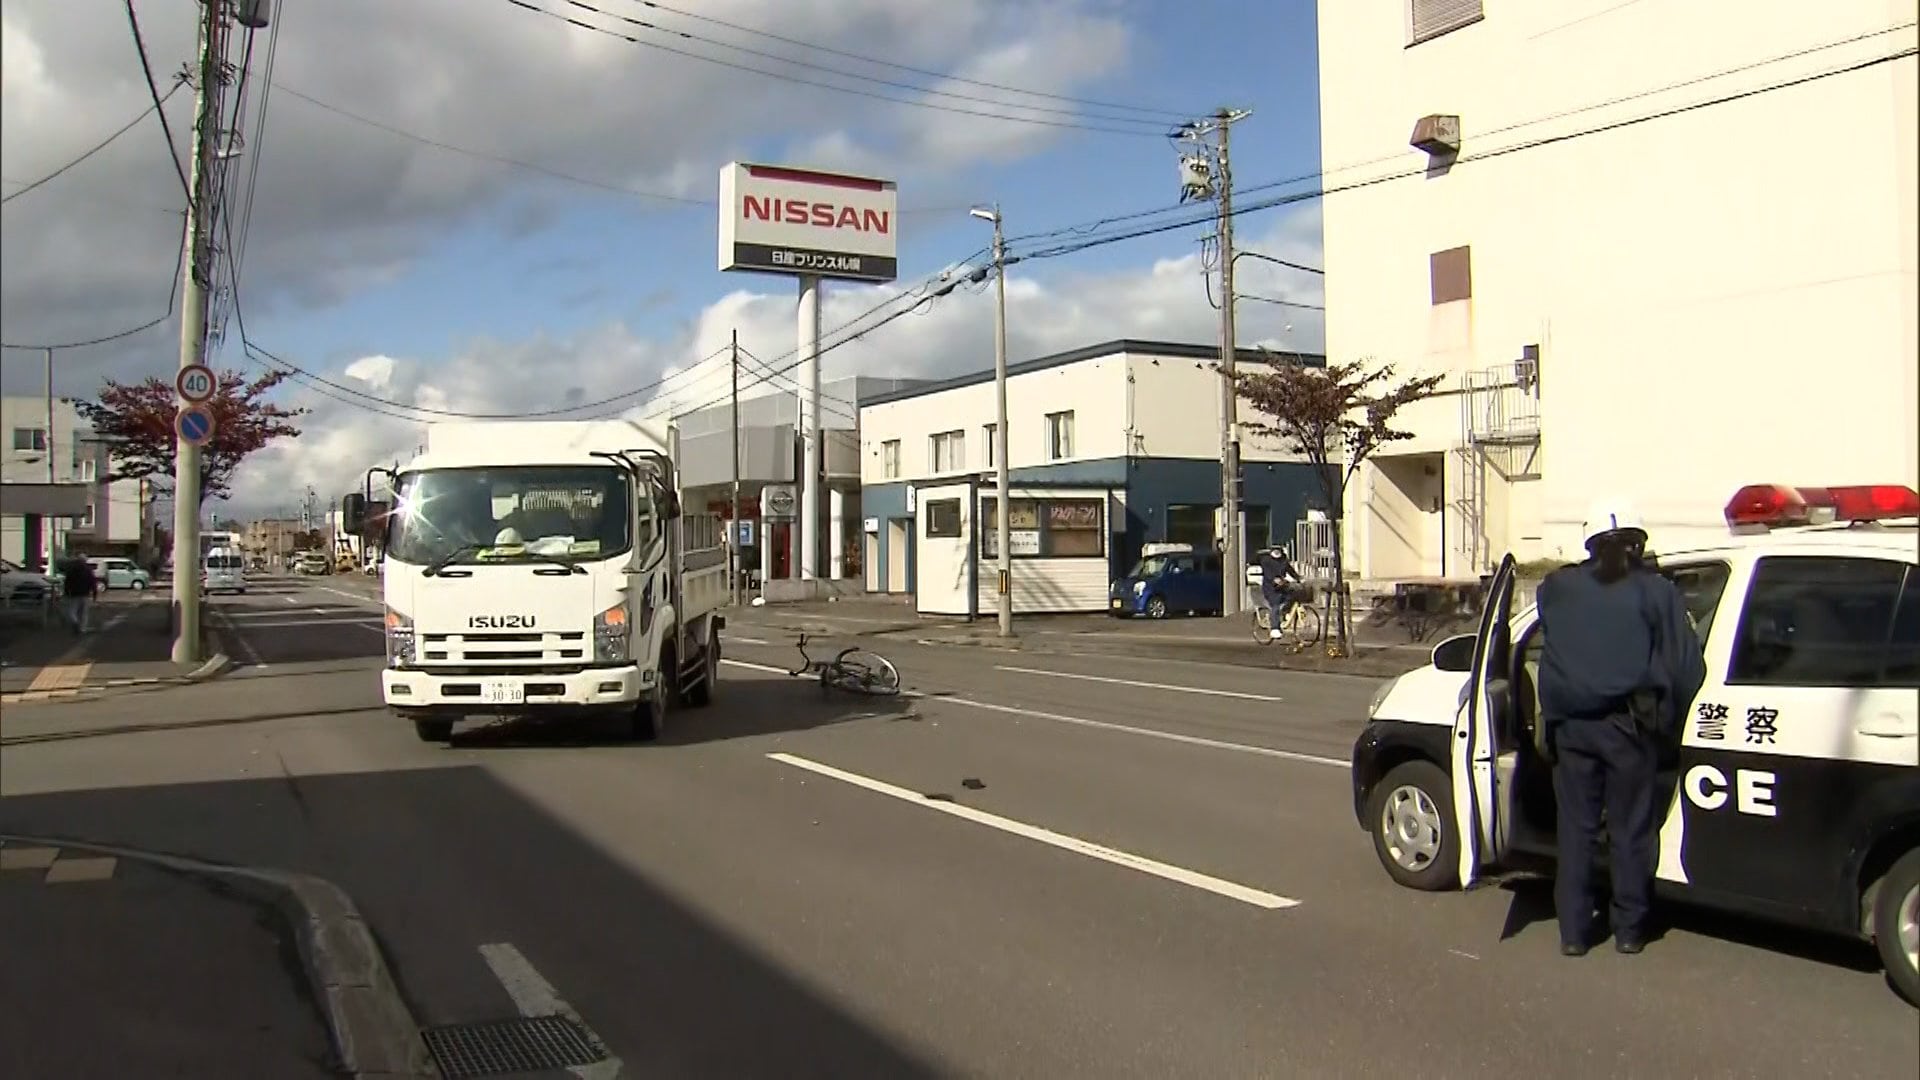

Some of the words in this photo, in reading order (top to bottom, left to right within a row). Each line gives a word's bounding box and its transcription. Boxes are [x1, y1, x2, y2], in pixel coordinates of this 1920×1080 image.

[743, 194, 889, 234] NISSAN
[771, 250, 861, 272] 日産プリンス札幌
[186, 375, 207, 392] 40
[468, 614, 536, 628] ISUZU
[1696, 702, 1779, 744] 警察
[1684, 764, 1777, 816] CE
